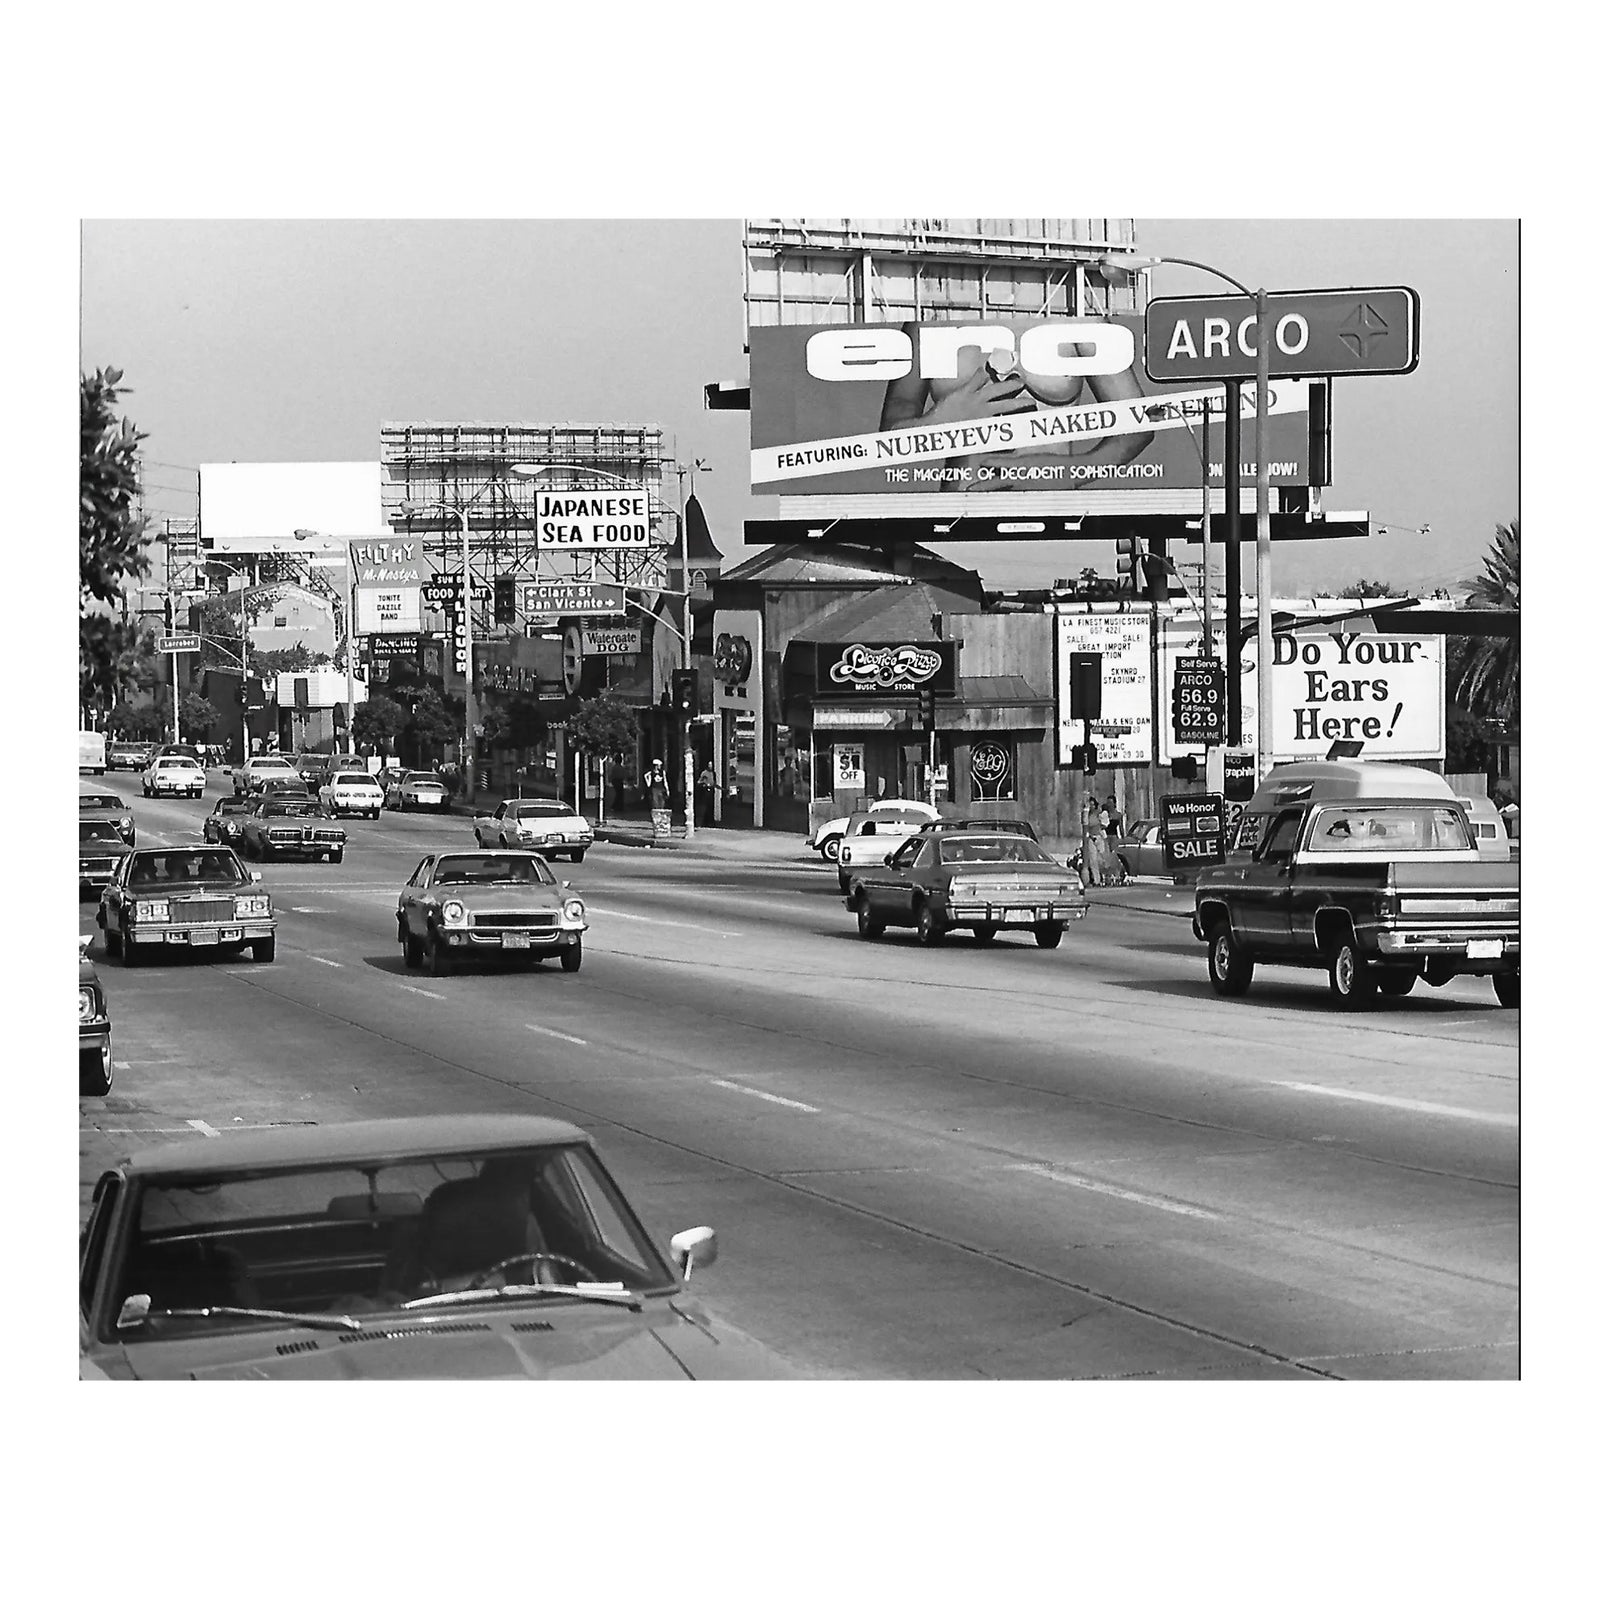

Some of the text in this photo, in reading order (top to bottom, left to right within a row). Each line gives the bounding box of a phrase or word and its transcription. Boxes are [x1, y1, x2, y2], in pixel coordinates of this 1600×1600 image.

[1165, 313, 1310, 360] ARCO
[777, 389, 1278, 469] FEATURING: NUREYEV'S NAKED VLENTNO
[885, 464, 1164, 483] THE MAGAZINE OF DECADENT SOPHISTICATION
[1239, 463, 1258, 477] ALE
[1268, 462, 1298, 476] OW!
[539, 496, 644, 518] JAPANESE
[542, 522, 646, 543] SEA FOOD
[356, 543, 415, 566] FILTHY
[378, 594, 401, 602] TONITE
[427, 588, 454, 599] FOOD
[539, 587, 592, 598] Clark St
[527, 598, 603, 610] San Vicente
[381, 612, 398, 620] BAND
[1078, 619, 1102, 627] FINEST
[1104, 618, 1126, 626] MUSIC
[1105, 626, 1121, 634] 4221
[454, 601, 466, 673] LIQUOR
[597, 644, 629, 653] DOG
[1077, 642, 1131, 651] GREAT IMPORT
[1272, 632, 1422, 666] Do Your
[1101, 651, 1122, 659] CTION
[1180, 659, 1218, 668] Self Serve
[1103, 677, 1136, 685] STADIUM
[1180, 674, 1213, 686] ARCO
[855, 683, 915, 691] MUSIC STORE
[1304, 670, 1388, 702] Ears
[1181, 689, 1218, 703] 56.9
[1193, 704, 1212, 712] Serve
[1120, 717, 1133, 725] ENG
[1136, 717, 1151, 725] DAN
[1180, 712, 1218, 727] 62.9
[1293, 702, 1403, 740] Here!
[1180, 731, 1219, 740] GASOLINE
[1109, 743, 1126, 751] MAC
[1098, 751, 1119, 760] ORUM
[840, 770, 859, 780] OFF
[1169, 804, 1185, 814] We
[1186, 803, 1216, 813] Honor
[1173, 840, 1219, 859] SALE
